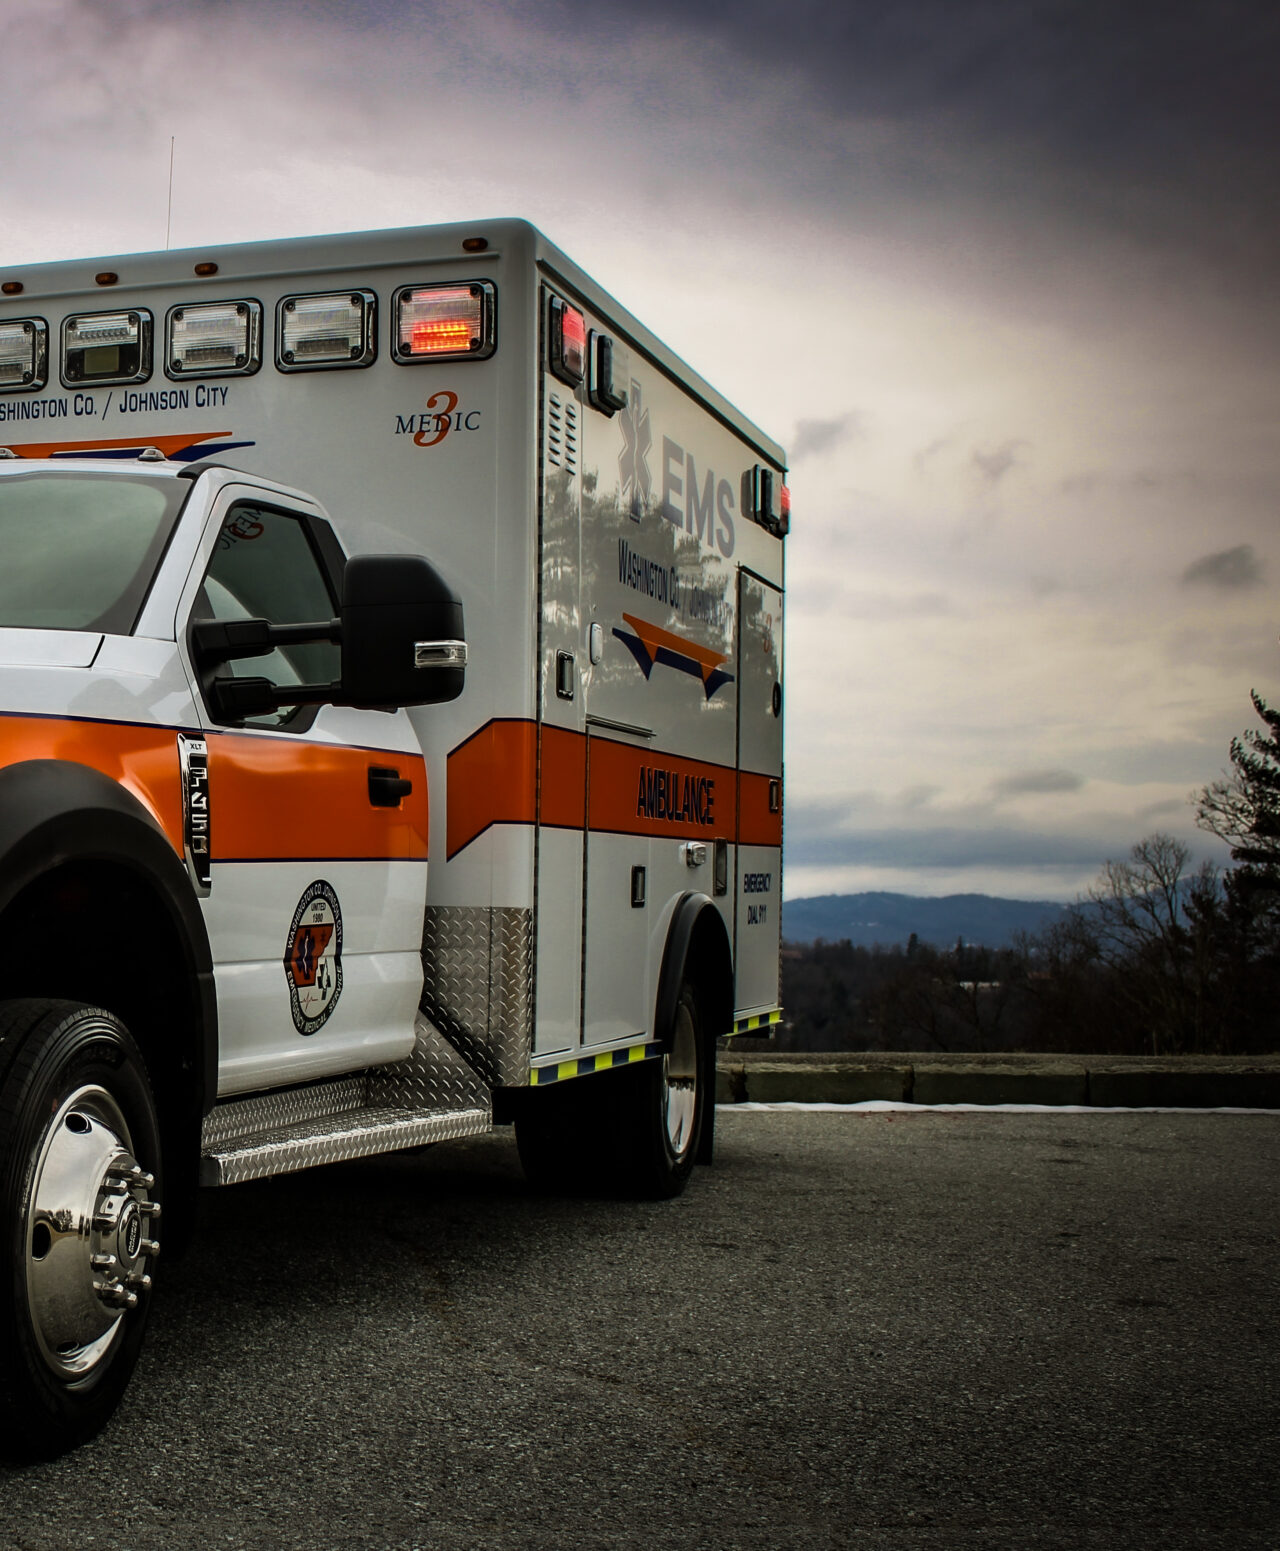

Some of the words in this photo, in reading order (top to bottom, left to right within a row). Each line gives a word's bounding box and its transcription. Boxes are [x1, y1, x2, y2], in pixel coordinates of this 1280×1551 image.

[395, 411, 481, 434] MEDIC
[414, 391, 458, 447] 3
[663, 434, 736, 559] EMS
[637, 766, 715, 826] AMBULANCE
[744, 873, 771, 893] EMERGENCY
